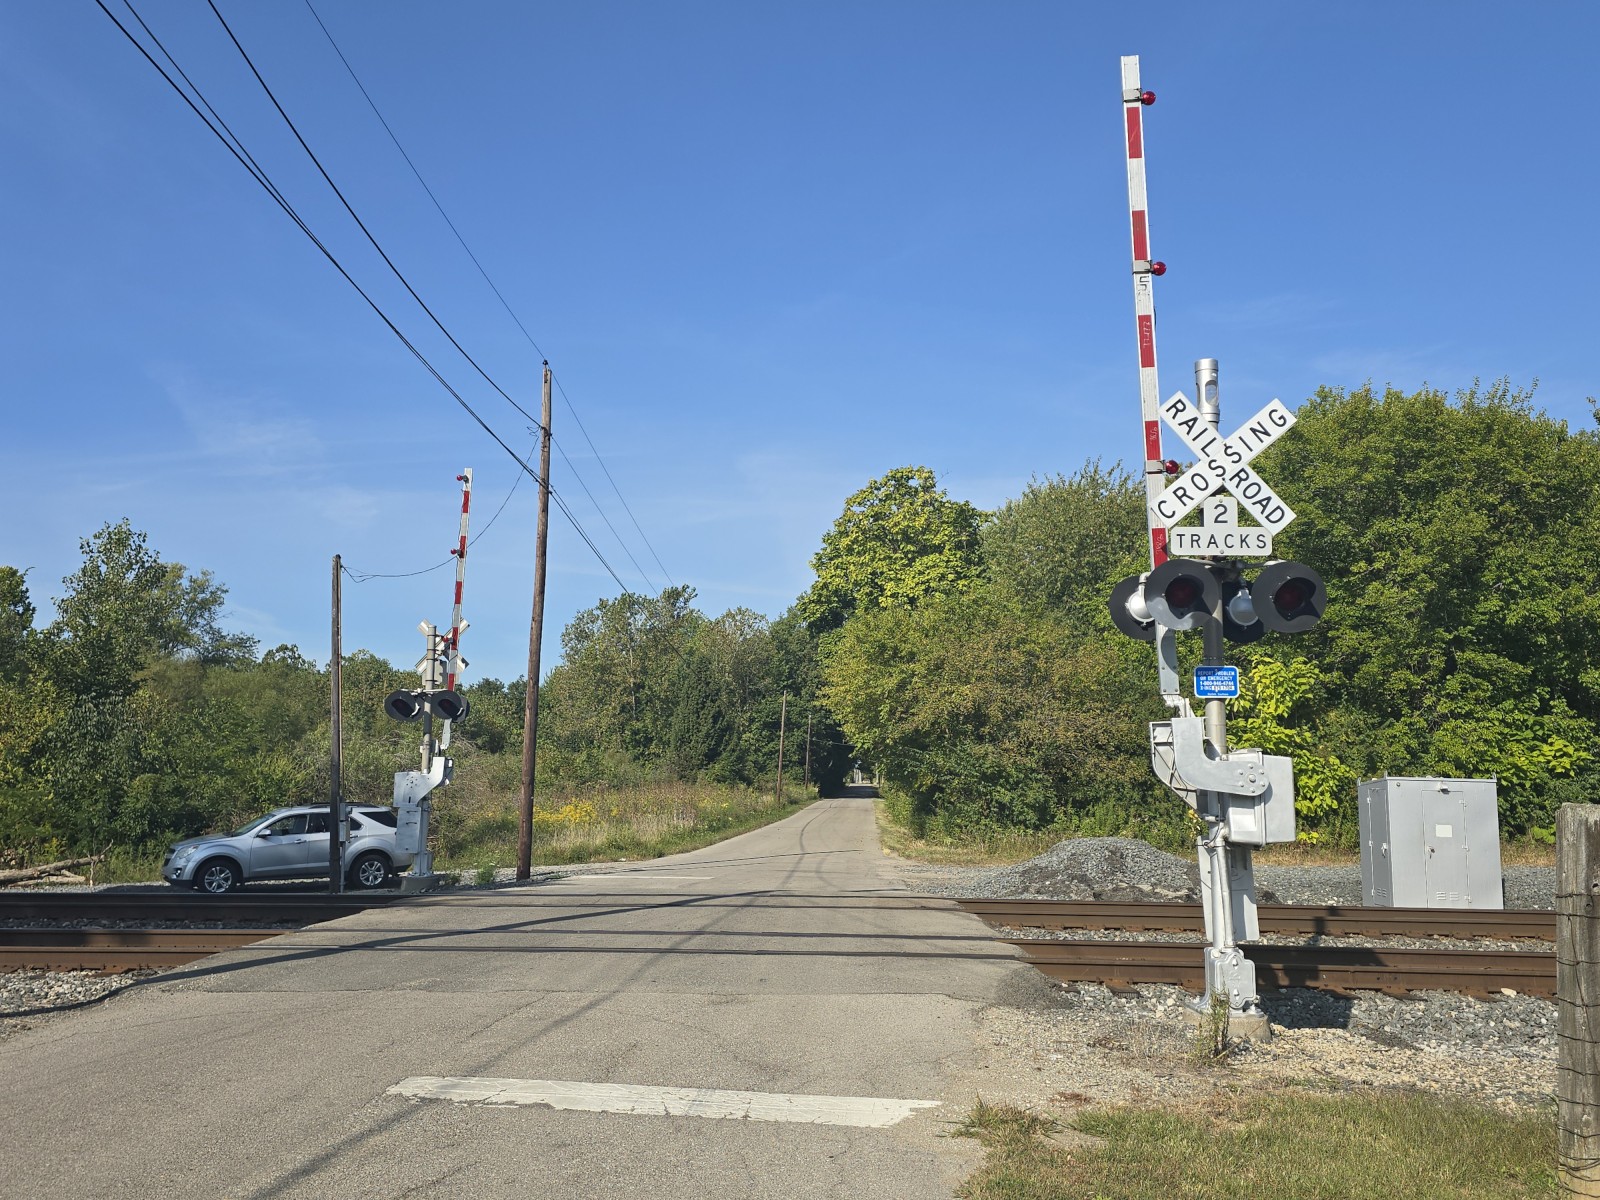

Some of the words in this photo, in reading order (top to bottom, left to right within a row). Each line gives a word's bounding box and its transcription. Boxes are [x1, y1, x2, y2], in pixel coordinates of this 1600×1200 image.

[1158, 408, 1287, 519] CROSSING
[1213, 503, 1229, 524] 2
[1176, 534, 1267, 549] TRACKS
